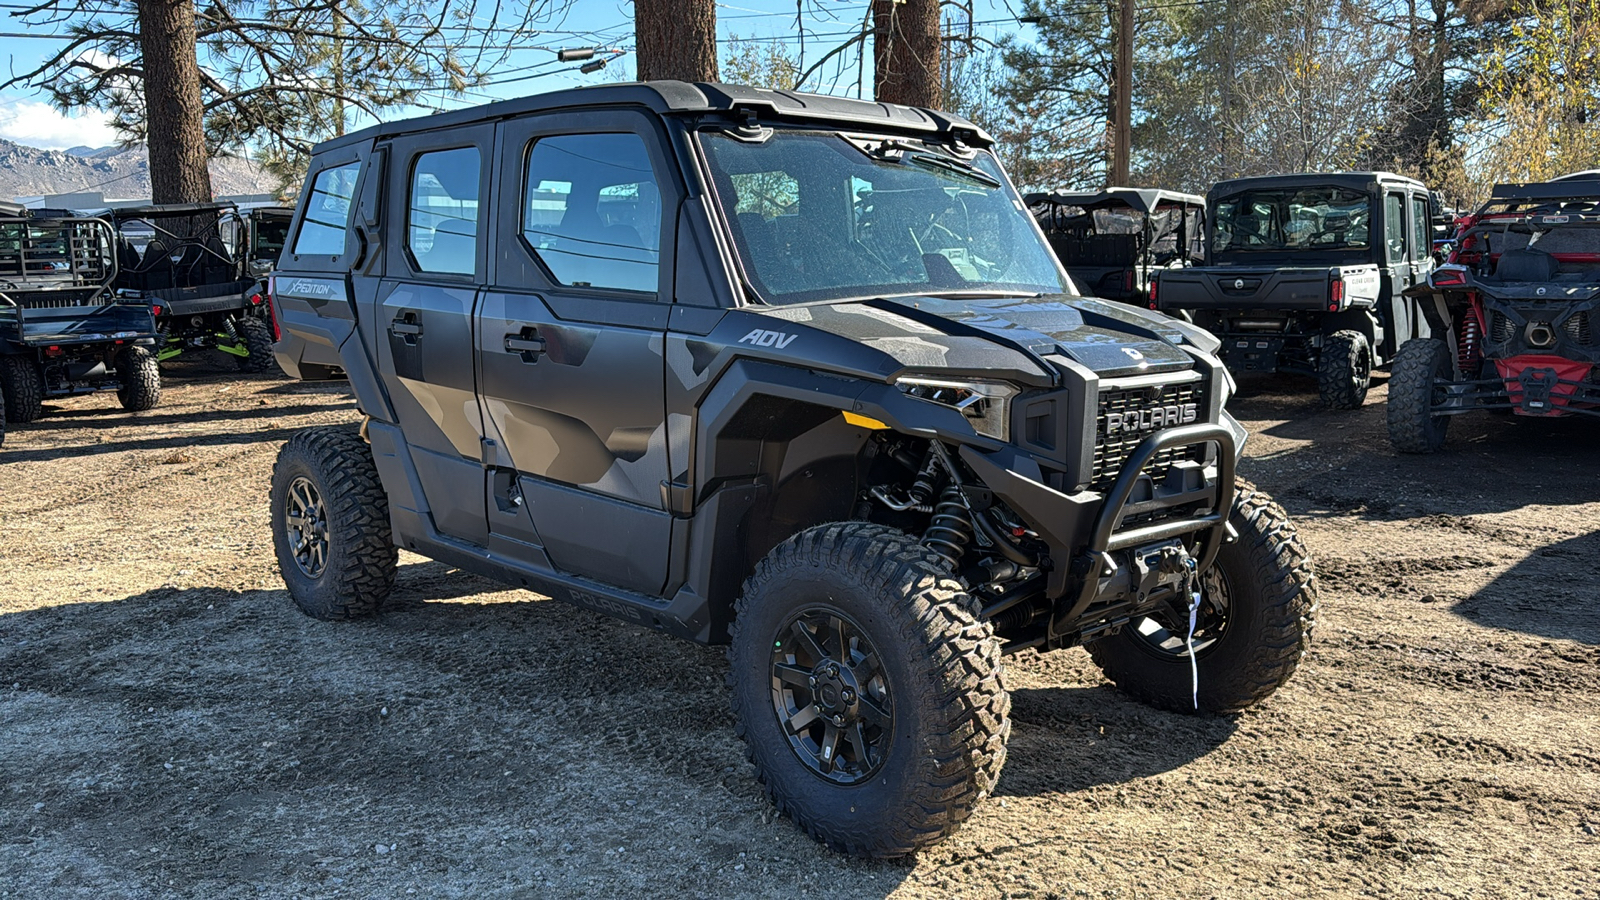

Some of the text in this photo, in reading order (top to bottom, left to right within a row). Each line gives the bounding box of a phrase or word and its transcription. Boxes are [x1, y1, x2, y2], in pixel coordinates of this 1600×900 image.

[288, 279, 330, 295] XPEDITION
[187, 301, 231, 313] Kawasaki
[738, 328, 799, 349] ADV
[1105, 403, 1196, 434] POLARIS
[569, 589, 641, 620] POLARIS
